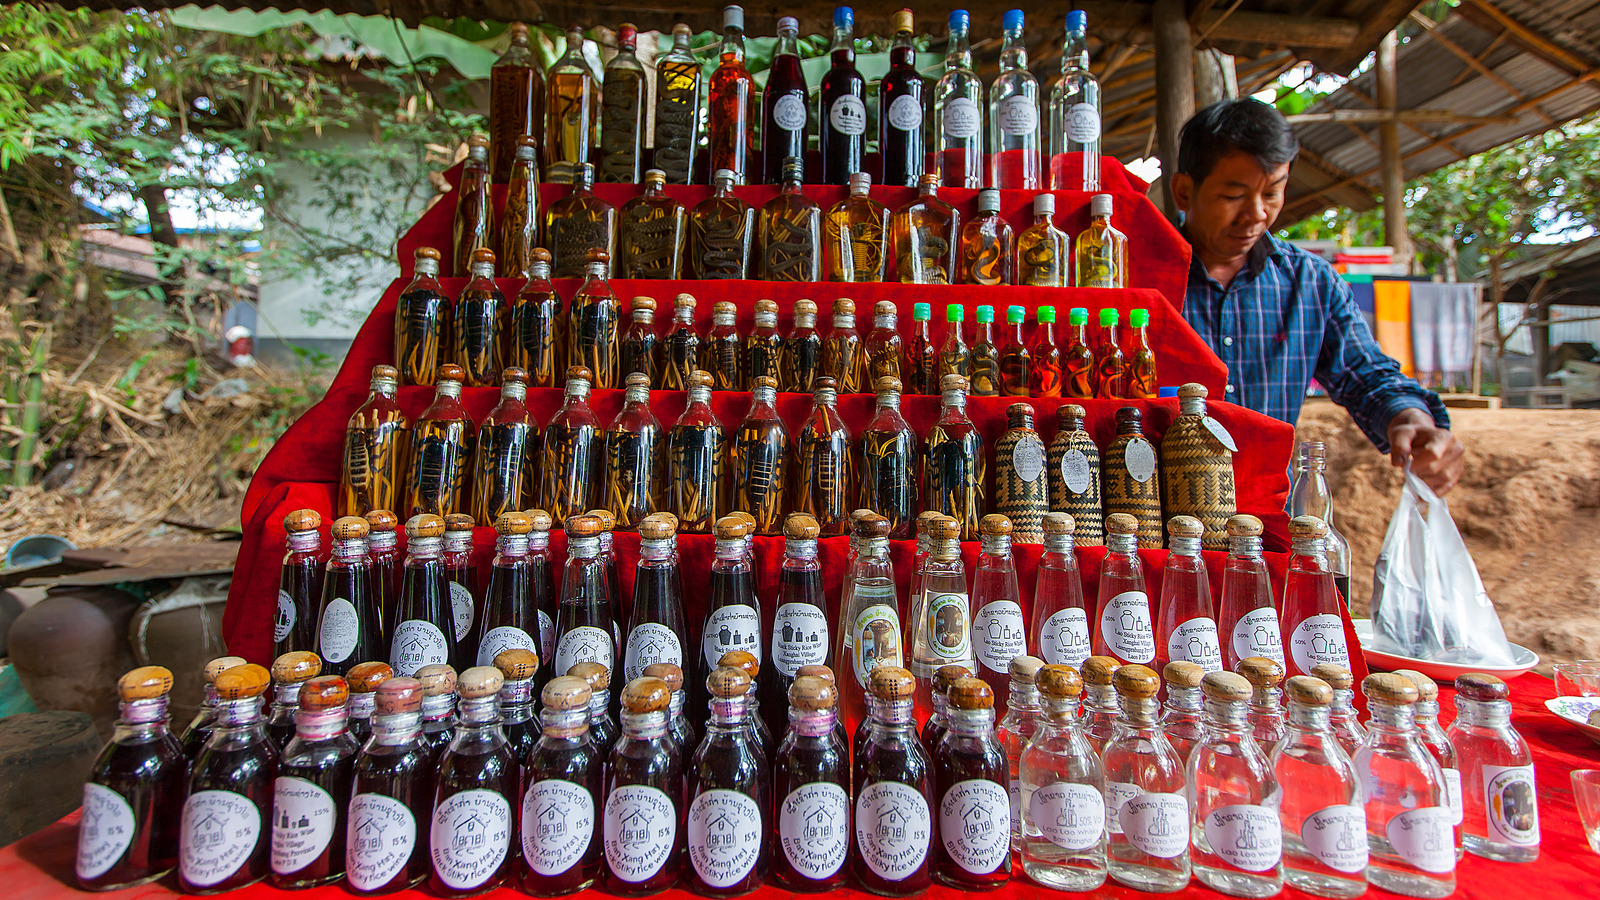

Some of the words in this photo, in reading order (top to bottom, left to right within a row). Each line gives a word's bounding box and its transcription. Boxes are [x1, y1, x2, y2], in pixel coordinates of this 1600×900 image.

[1115, 628, 1123, 636] Lao
[1123, 632, 1137, 640] Sticky
[983, 637, 991, 645] Lao
[991, 640, 1005, 648] Sticky
[1250, 644, 1258, 652] Lao
[1055, 645, 1063, 653] Lao
[1307, 651, 1316, 660] Lao
[1316, 655, 1330, 663] Sticky
[314, 808, 329, 817] 15%
[576, 817, 590, 829] 15%
[658, 826, 671, 838] 15%
[914, 831, 926, 840] 15%
[1042, 825, 1058, 833] Lao
[1059, 827, 1076, 836] Lao
[392, 835, 407, 847] 15%
[493, 831, 506, 843] 15%
[744, 831, 757, 843] 15%
[1133, 834, 1150, 843] Lao
[1151, 838, 1168, 846] Lao
[540, 847, 562, 858] Xang
[556, 854, 573, 866] rice
[573, 834, 590, 855] wine
[783, 837, 799, 864] Black
[821, 859, 836, 871] rice
[793, 838, 805, 855] Ban
[805, 850, 828, 862] Xang
[858, 830, 871, 858] Black
[891, 862, 907, 872] rice
[907, 848, 925, 867] wine
[866, 833, 877, 851] Ban
[876, 847, 899, 864] Xang
[947, 840, 966, 864] Black
[957, 838, 971, 855] Ban
[972, 846, 995, 858] Xang
[1221, 848, 1238, 856] Lao
[1321, 850, 1338, 858] Lao
[453, 859, 478, 870] Xang
[470, 868, 487, 880] rice
[487, 847, 505, 869] wine
[621, 853, 644, 864] Xang
[637, 862, 654, 874] rice
[654, 844, 670, 864] wine
[709, 857, 732, 870] Xang
[725, 867, 741, 879] rice
[741, 848, 757, 868] wine
